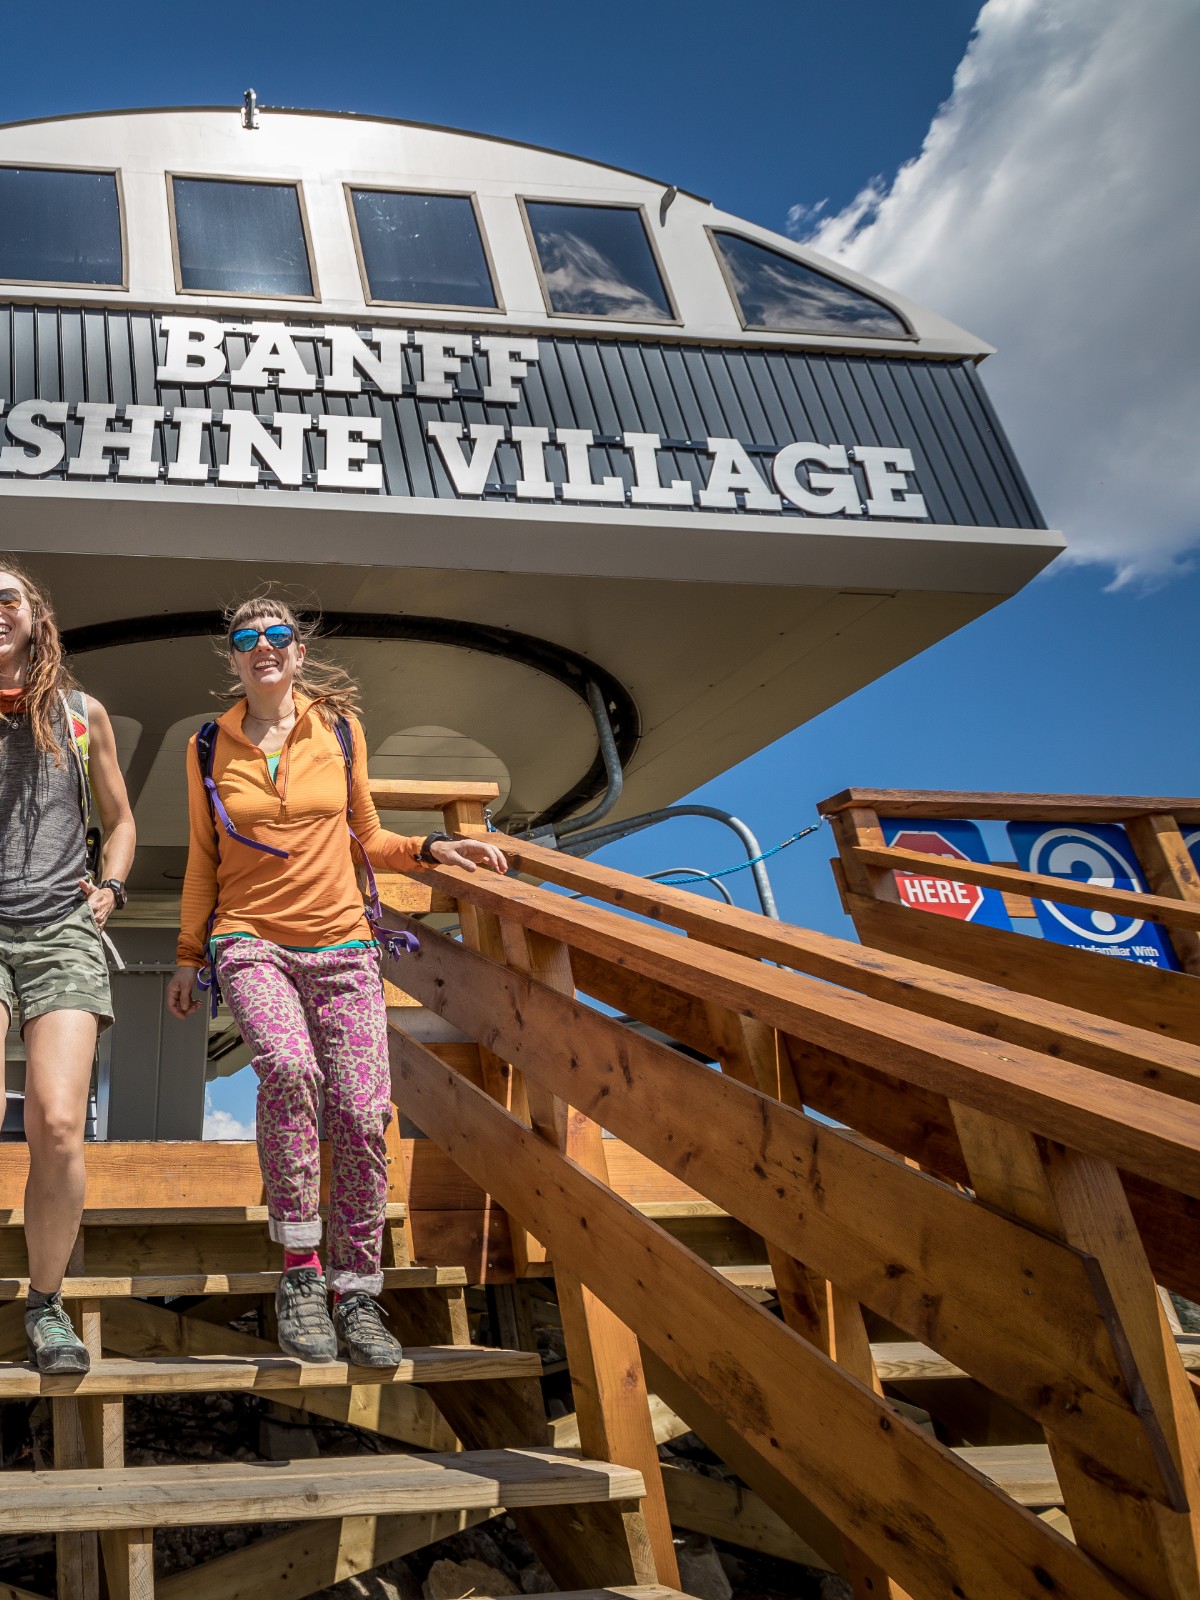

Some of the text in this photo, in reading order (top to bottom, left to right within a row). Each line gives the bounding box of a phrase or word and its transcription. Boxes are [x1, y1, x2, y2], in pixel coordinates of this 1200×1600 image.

[157, 316, 539, 404] BANFF
[427, 420, 928, 518] VILLAGE
[903, 879, 971, 904] HERE
[1075, 944, 1131, 956] familiar
[1131, 945, 1160, 957] With
